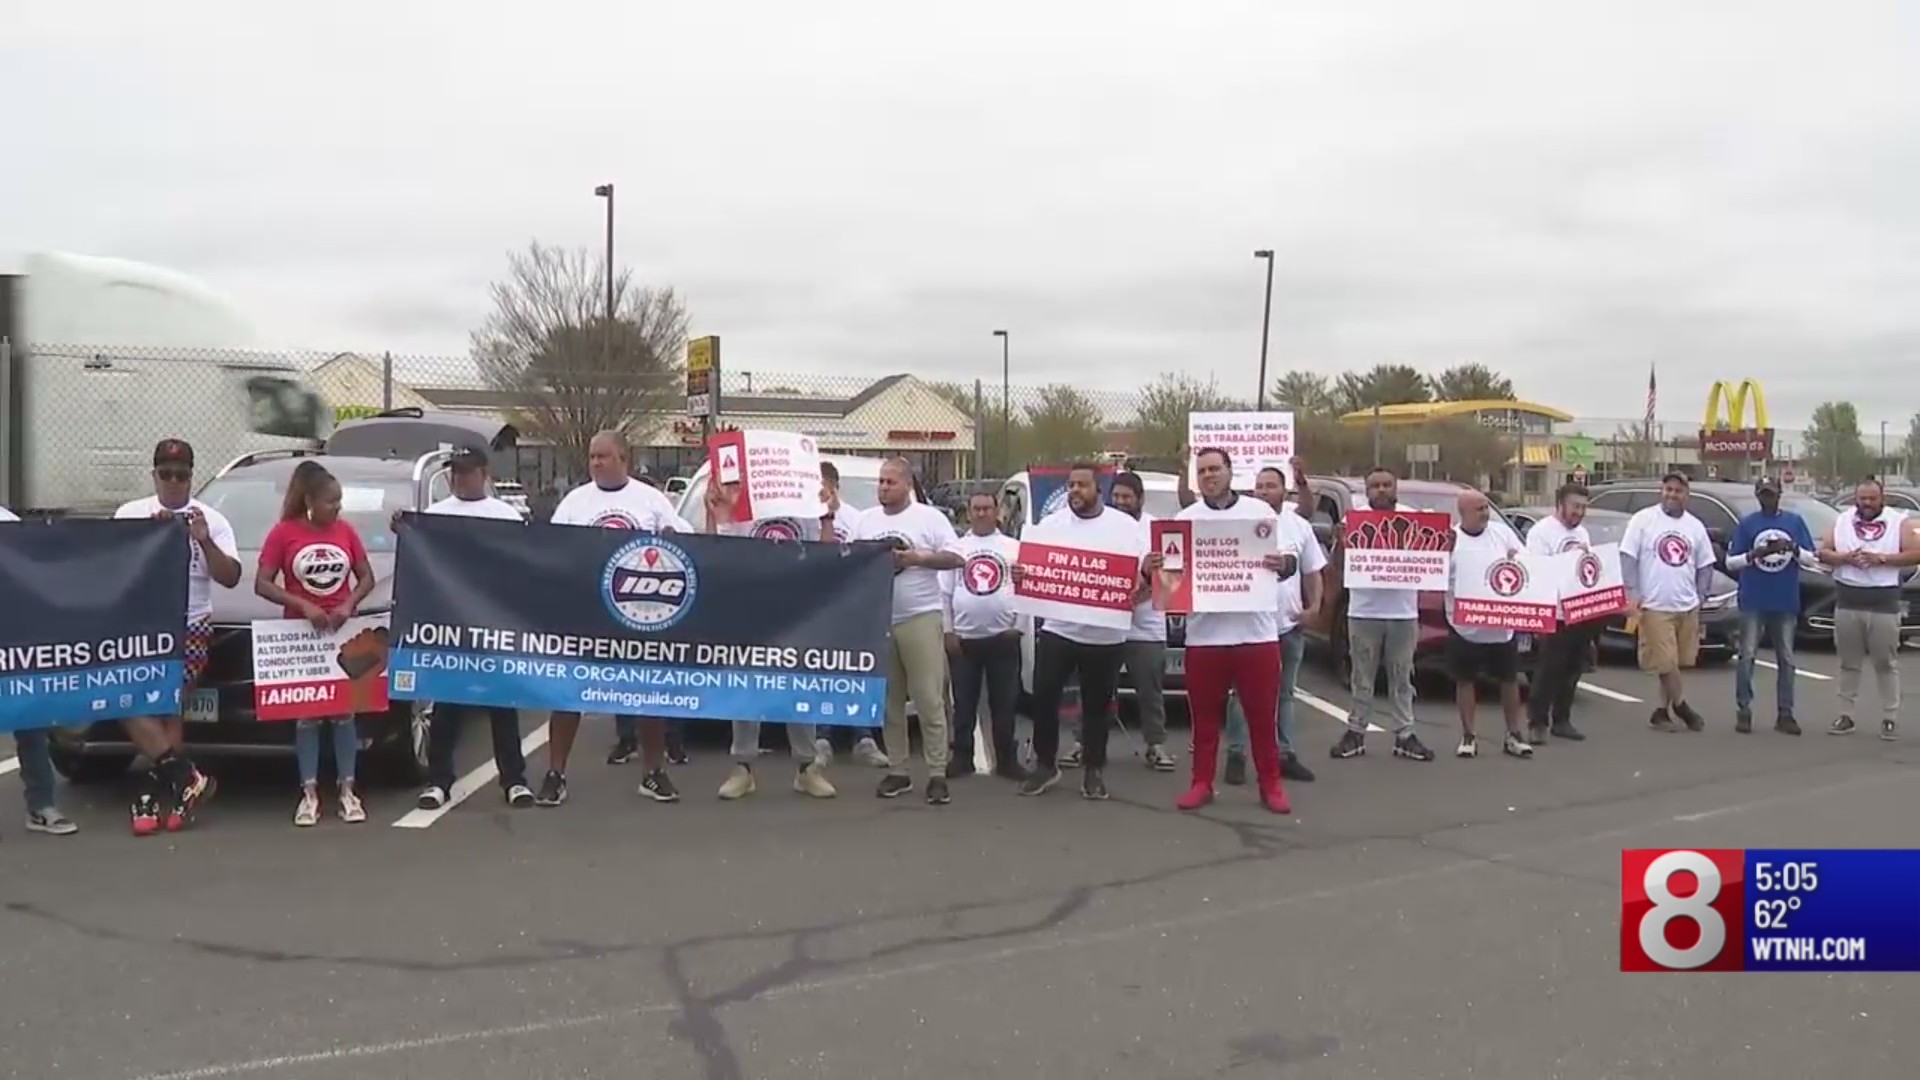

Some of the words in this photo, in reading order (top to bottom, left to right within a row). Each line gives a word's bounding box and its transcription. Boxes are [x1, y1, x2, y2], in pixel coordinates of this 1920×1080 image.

[1193, 423, 1225, 431] HUELGA
[1227, 423, 1242, 431] DEL
[1253, 423, 1264, 431] DE
[1266, 423, 1288, 431] MAYO
[1194, 433, 1211, 442] LOS
[1214, 433, 1288, 442] TRABAJADORES
[749, 447, 769, 456] QUE
[1242, 446, 1255, 455] SE
[1257, 446, 1289, 455] UNEN
[1195, 538, 1216, 547] QUE
[1220, 538, 1239, 546] LOS
[1195, 549, 1239, 558] BUENOS
[1350, 555, 1368, 563] LOS
[1370, 555, 1444, 565] TRABAJADORES
[1048, 552, 1068, 566] FIN
[1070, 555, 1079, 567] A
[1081, 556, 1107, 570] LAS
[1350, 564, 1362, 572] DE
[1364, 564, 1383, 573] APP
[1386, 565, 1427, 574] QUIEREN
[1429, 566, 1443, 574] UN
[1196, 573, 1243, 581] VUELVAN
[1245, 573, 1253, 581] A
[1371, 575, 1422, 583] SINDICATO
[619, 576, 685, 597] IDG
[1021, 579, 1081, 598] INJUSTAS
[1082, 587, 1099, 601] DE
[1101, 591, 1127, 603] APP
[1197, 584, 1250, 593] TRABAJAR
[1458, 601, 1537, 616] TRABAJADORES
[1538, 607, 1552, 617] DE
[1465, 614, 1486, 624] APP
[1487, 615, 1501, 624] EN
[1503, 616, 1544, 628] HUELGA
[257, 632, 300, 643] SUELDOS
[98, 632, 174, 662] GUILD
[258, 645, 287, 656] ALTOS
[290, 643, 315, 653] PARA
[317, 642, 336, 652] LOS
[405, 623, 461, 646] JOIN
[468, 628, 515, 651] THE
[522, 632, 690, 662] INDEPENDENT
[696, 644, 798, 668] DRIVERS
[804, 649, 876, 672] GUILD
[257, 655, 326, 667] CONDUCTORES
[258, 670, 271, 680] DE
[272, 668, 295, 679] LYFT
[297, 667, 304, 676] Y
[306, 666, 331, 676] UBER
[412, 653, 496, 673] LEADING
[503, 659, 567, 679] DRIVER
[573, 664, 721, 688] ORGANIZATION
[727, 672, 748, 689] IN
[754, 674, 787, 690] THE
[792, 676, 866, 694] NATION
[10, 678, 34, 696] IN
[41, 675, 79, 693] THE
[87, 664, 166, 689] NATION
[261, 685, 336, 706] ¡AHORA!
[580, 687, 699, 711] drivingguild.org
